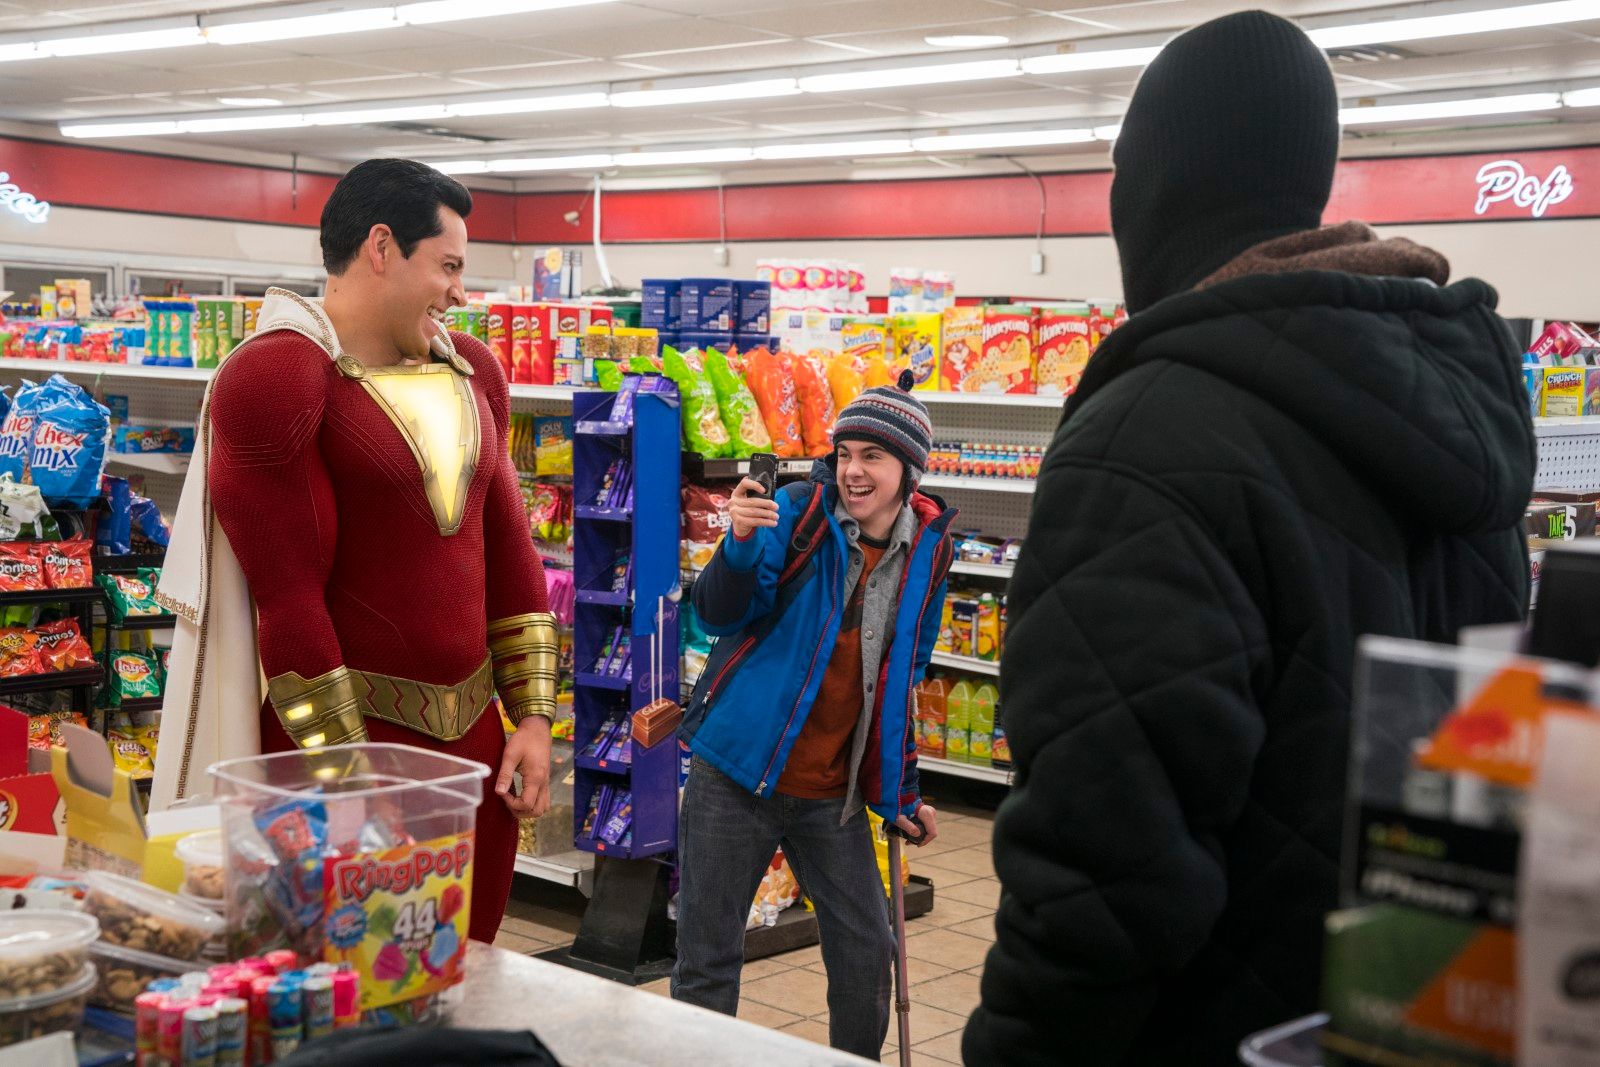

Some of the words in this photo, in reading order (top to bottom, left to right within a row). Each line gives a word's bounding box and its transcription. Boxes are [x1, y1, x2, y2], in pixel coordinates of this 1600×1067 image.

[1475, 160, 1573, 217] Pop
[983, 319, 1030, 343] Honeycomb
[1040, 321, 1088, 346] Honeycomb
[1546, 373, 1582, 384] CRUNCH
[35, 421, 84, 447] Chex
[33, 446, 77, 469] mix
[1548, 513, 1565, 538] TAKE
[1564, 505, 1577, 541] 5
[45, 554, 81, 567] Doritos
[393, 897, 438, 942] 44
